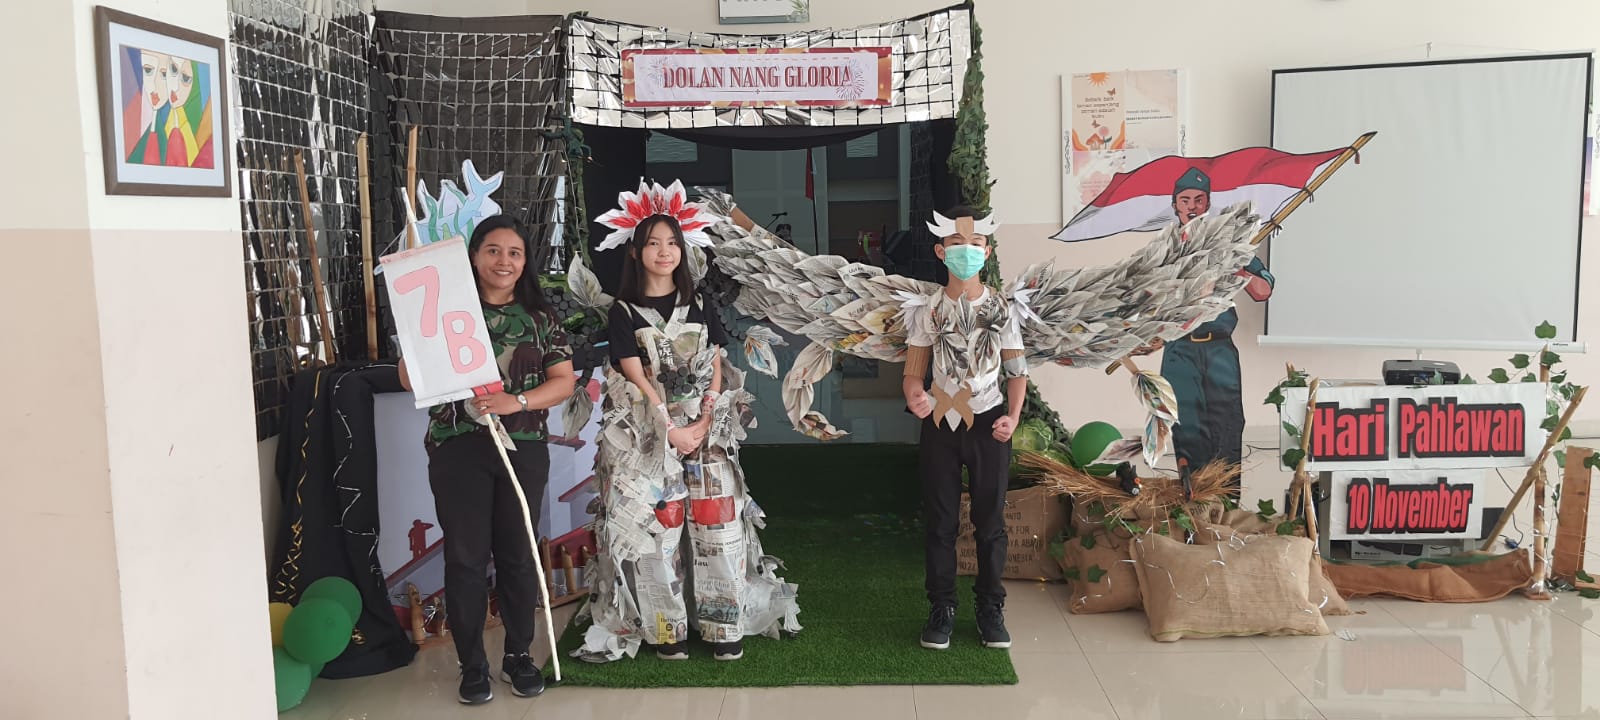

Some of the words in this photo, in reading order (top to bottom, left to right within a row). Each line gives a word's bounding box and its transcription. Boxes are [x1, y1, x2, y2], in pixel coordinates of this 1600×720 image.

[664, 66, 724, 89] DOLAN
[729, 65, 780, 88] NANG
[785, 65, 851, 87] GLORIA
[1311, 402, 1386, 459] Hari
[1399, 401, 1525, 455] Pahlawan
[1347, 481, 1370, 530] 10
[1372, 482, 1473, 530] November
